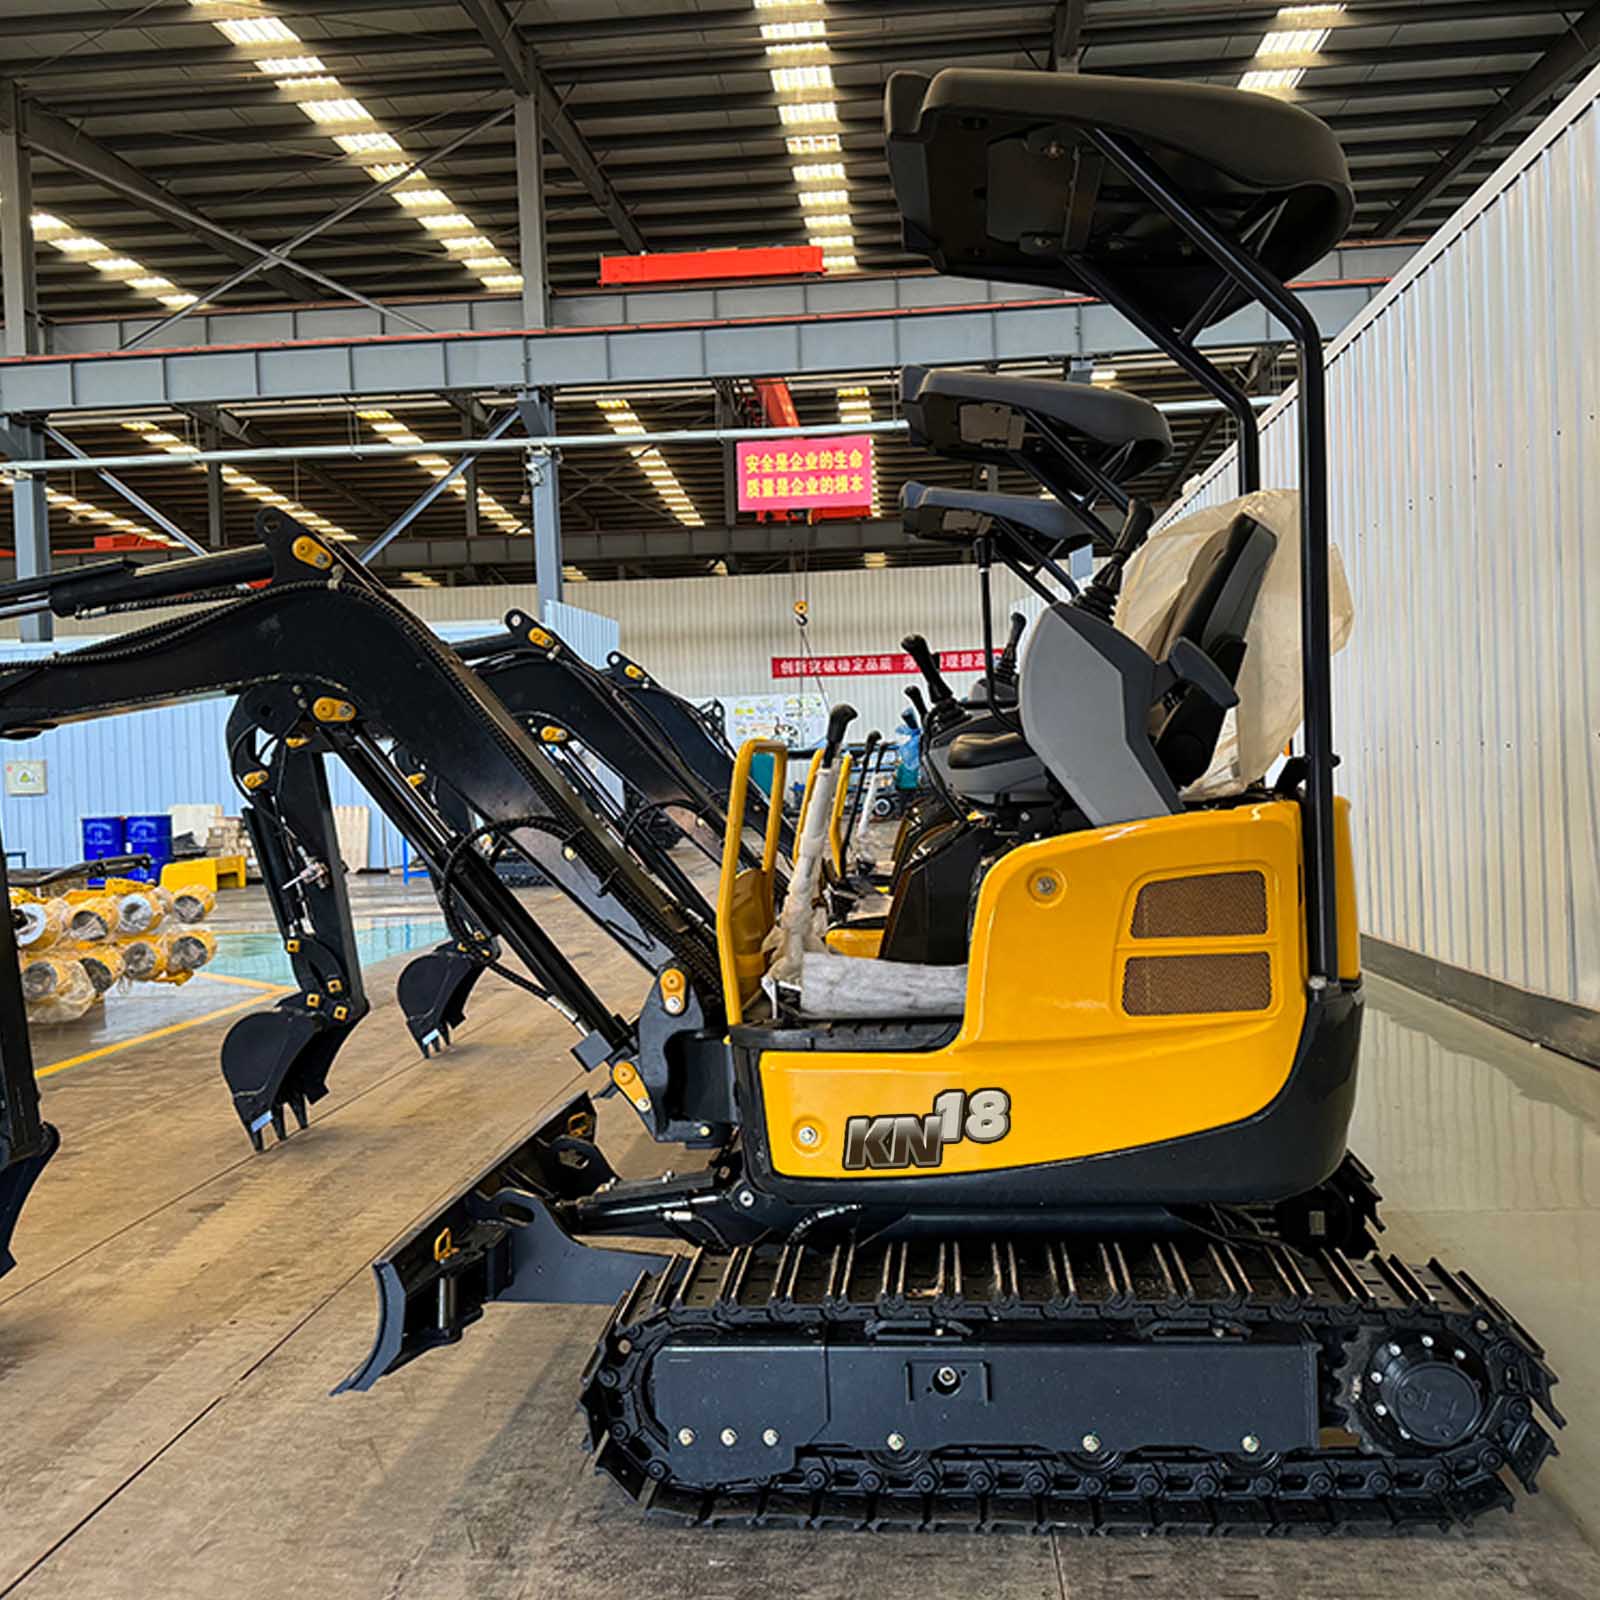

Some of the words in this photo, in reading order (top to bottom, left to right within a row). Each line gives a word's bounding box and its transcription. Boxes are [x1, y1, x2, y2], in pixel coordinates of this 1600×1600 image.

[745, 448, 863, 474] 安全是企业的生命
[746, 474, 864, 498] 质量是企业的根本
